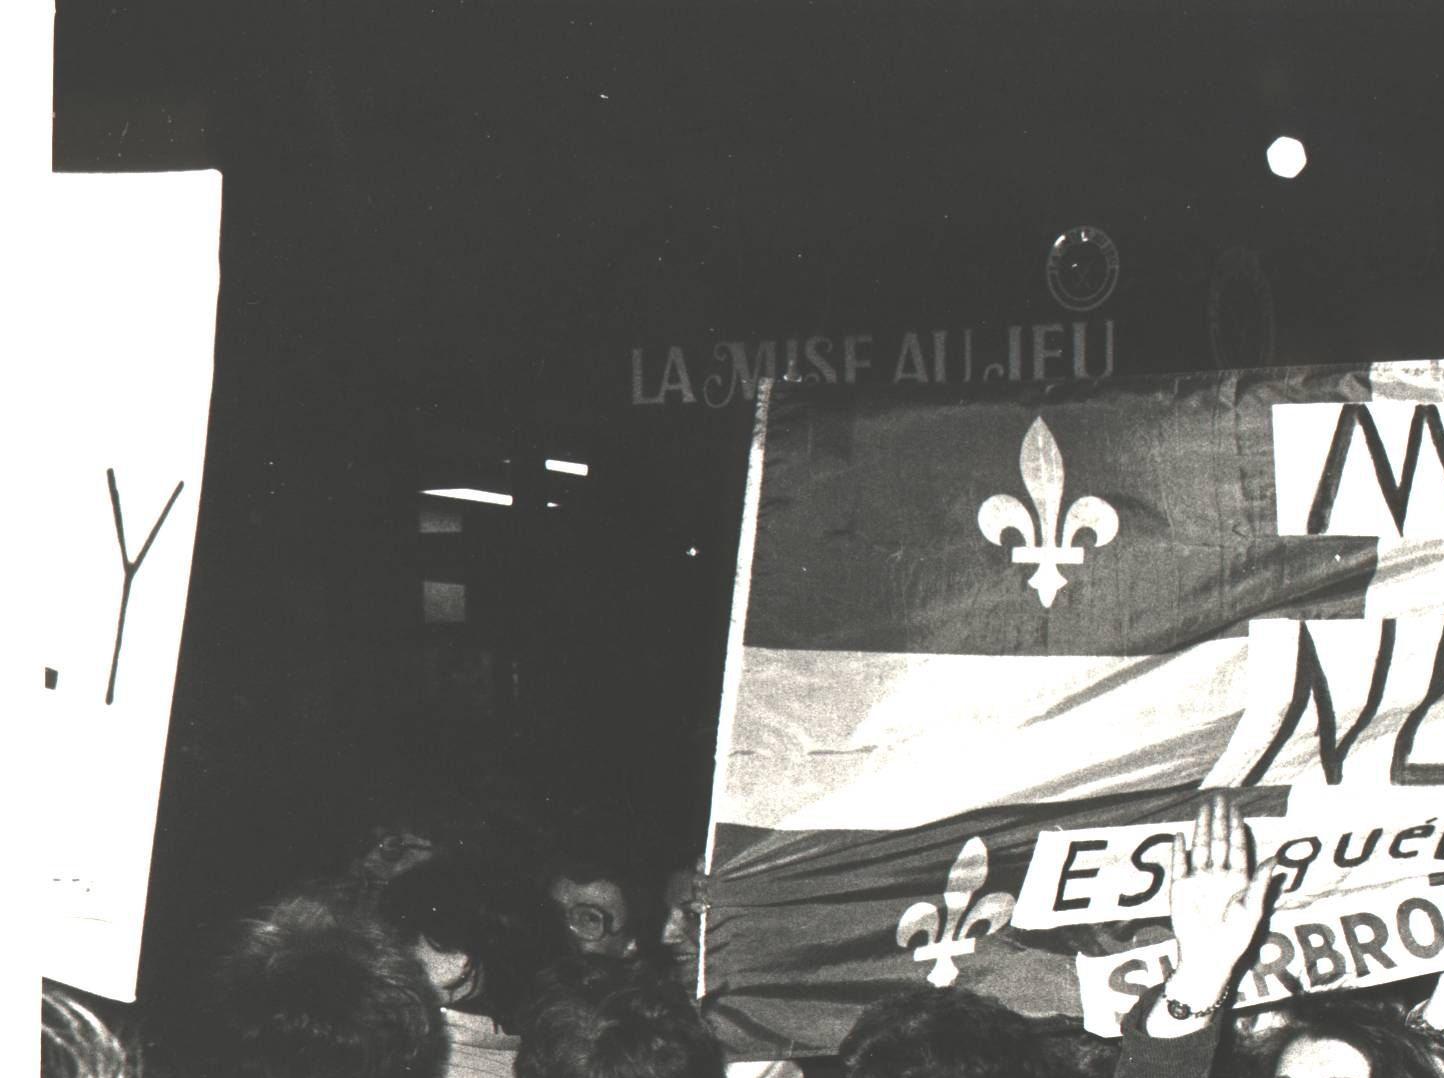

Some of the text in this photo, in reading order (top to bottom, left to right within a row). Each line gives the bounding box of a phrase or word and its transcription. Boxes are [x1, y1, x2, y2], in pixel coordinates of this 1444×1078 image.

[632, 319, 1115, 408] LA MISE AU JEU
[1052, 833, 1178, 912] ES
